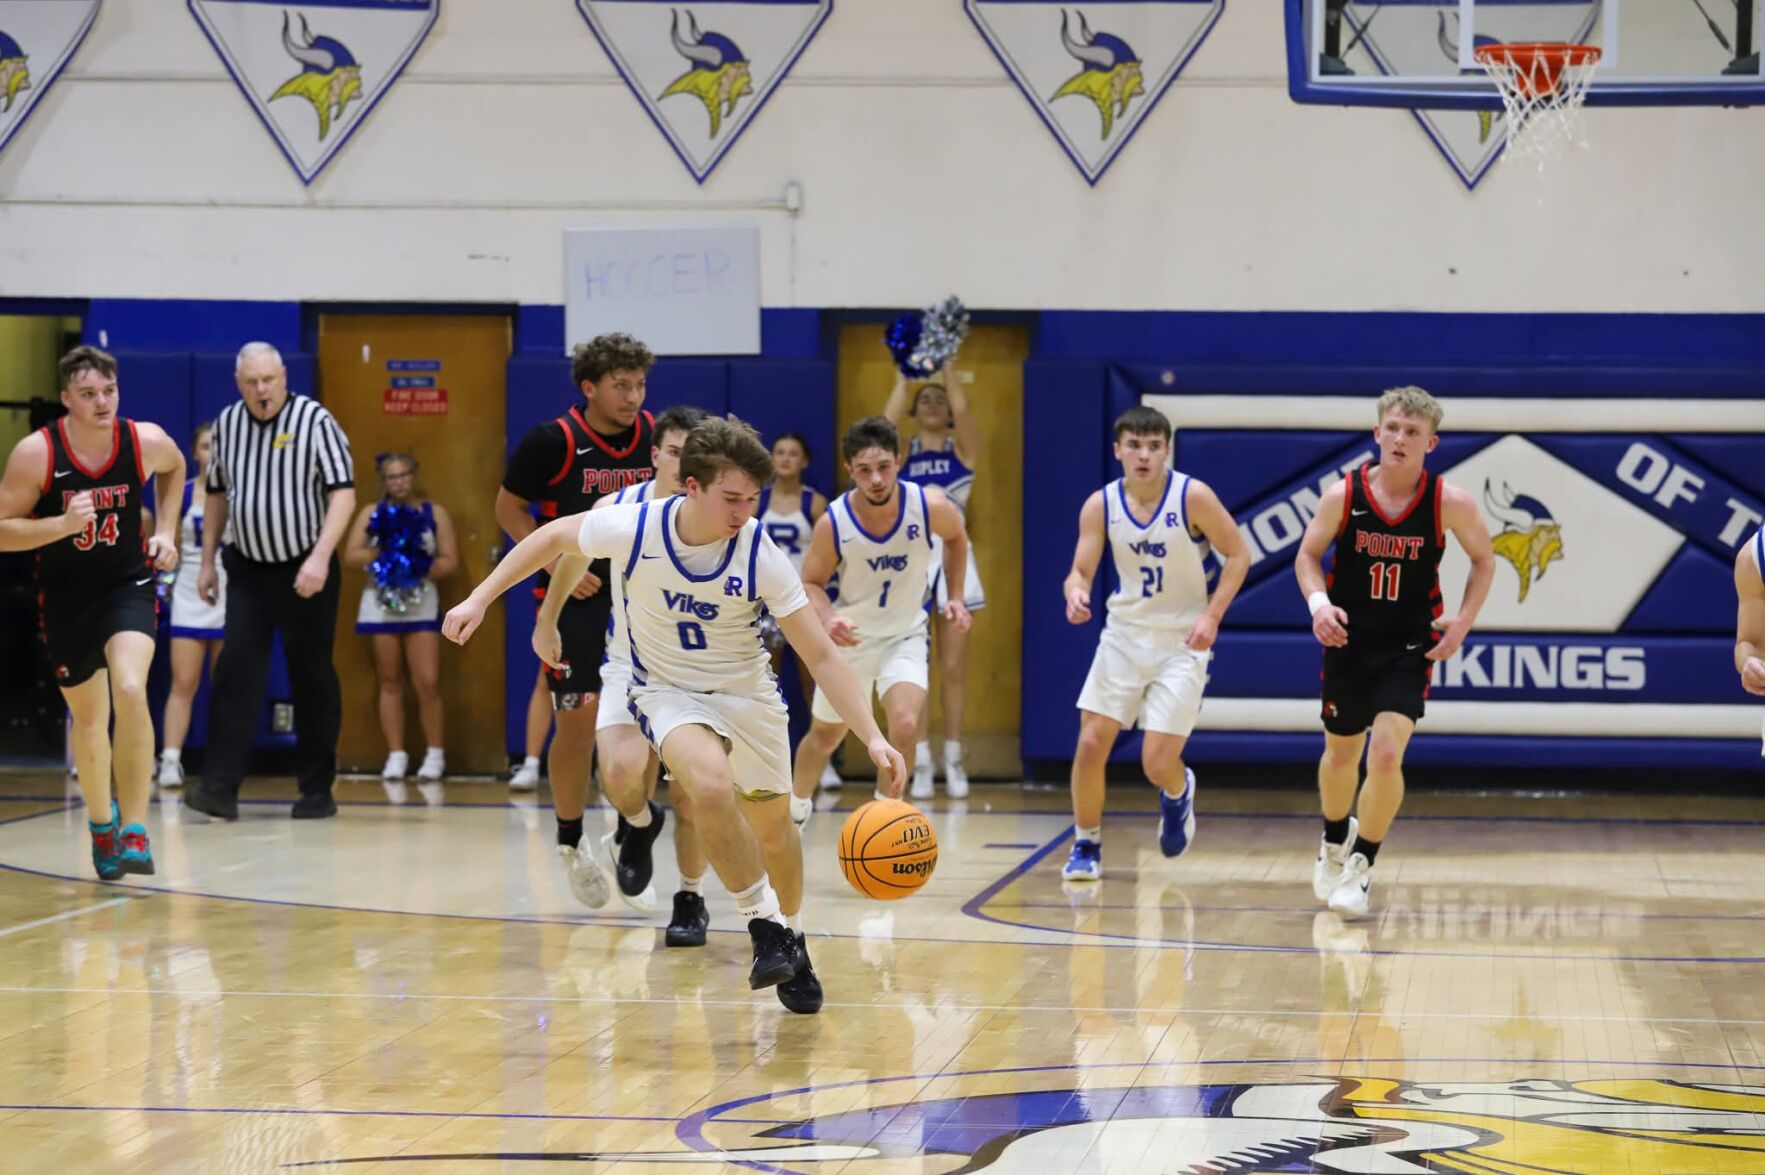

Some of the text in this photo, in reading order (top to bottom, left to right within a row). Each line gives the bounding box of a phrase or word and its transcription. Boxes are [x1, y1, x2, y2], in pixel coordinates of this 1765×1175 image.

[582, 467, 653, 494] POINT
[1615, 442, 1706, 509] OF
[1717, 497, 1763, 549] T
[62, 484, 129, 512] PINT
[73, 513, 119, 551] 34
[766, 523, 802, 554] R
[1355, 529, 1424, 560] POINT
[879, 580, 891, 608] 1
[1139, 566, 1163, 598] 21
[1369, 561, 1401, 602] 11
[677, 621, 707, 650] 0
